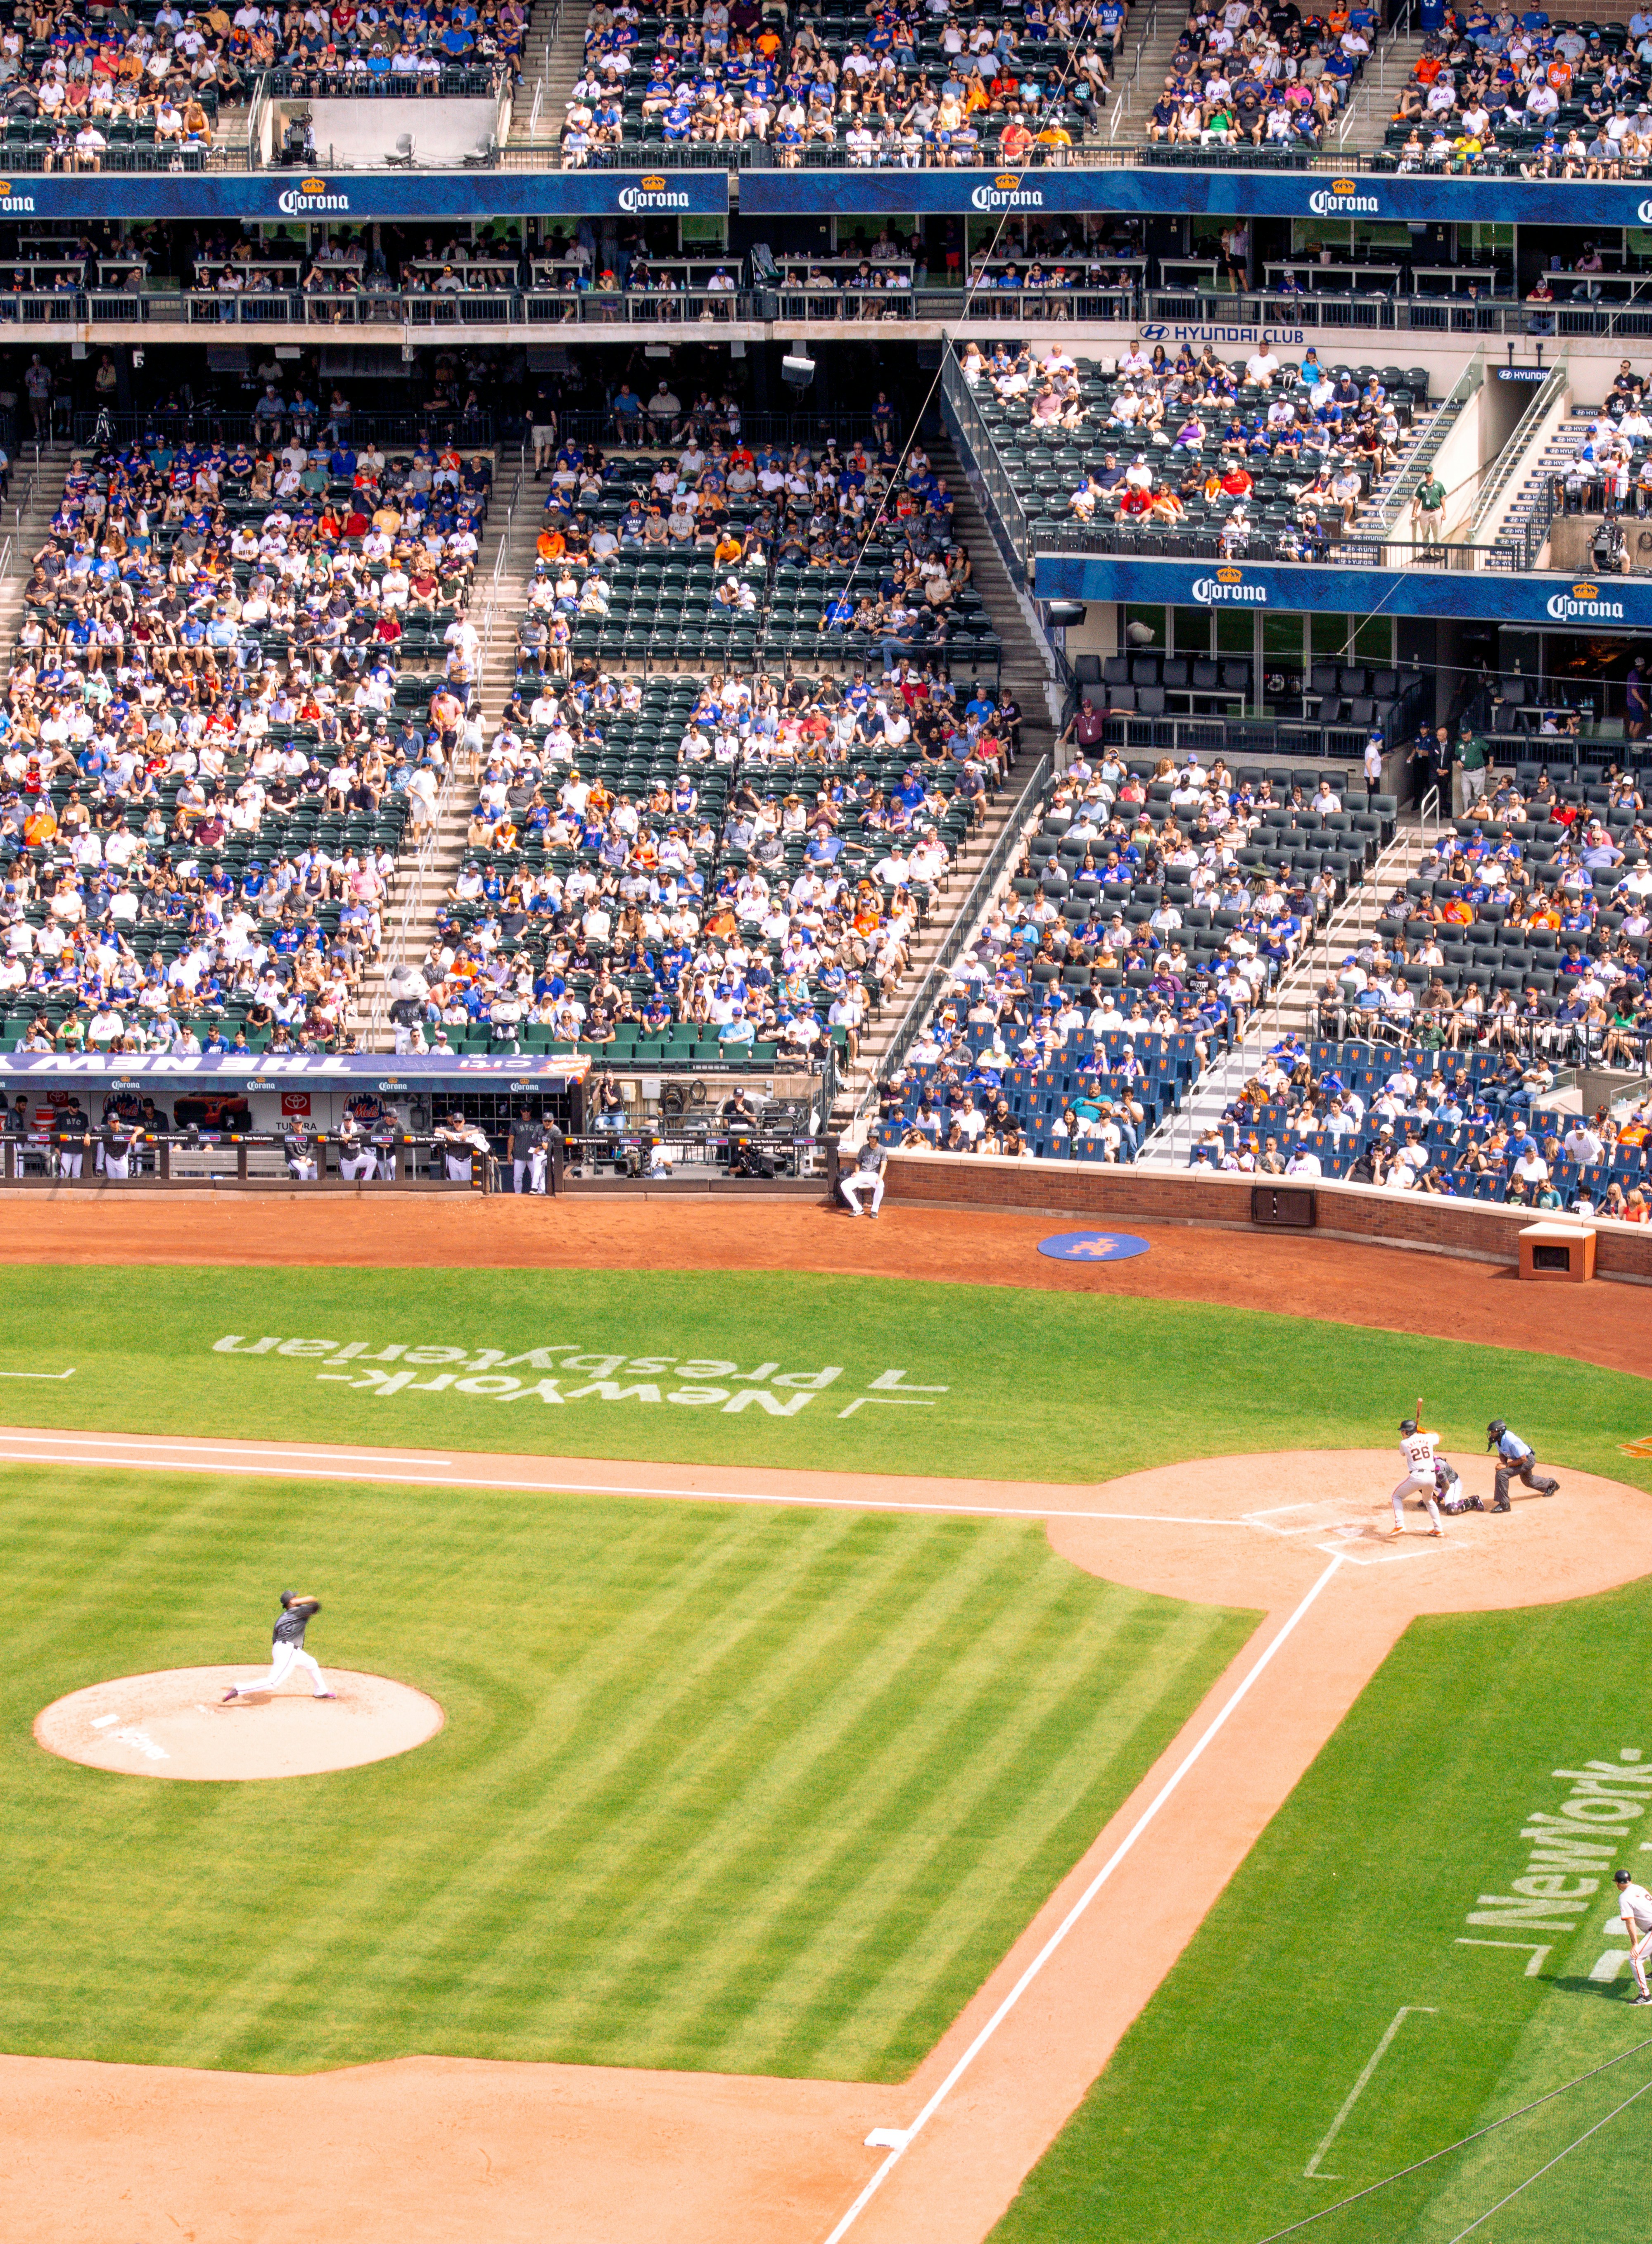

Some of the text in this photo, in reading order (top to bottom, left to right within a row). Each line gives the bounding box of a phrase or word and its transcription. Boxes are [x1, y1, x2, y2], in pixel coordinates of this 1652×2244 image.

[1533, 98, 1548, 107] Mets
[279, 190, 349, 215] Corona
[618, 187, 689, 213] Corona
[972, 186, 1042, 212] Corona
[1310, 190, 1378, 216] Corona
[1175, 326, 1303, 343] HYUNDAI CLUB
[1126, 357, 1142, 367] Mets
[1192, 578, 1266, 605] Corona
[1547, 594, 1623, 621] Corona
[1580, 991, 1597, 999] Mets
[29, 1056, 351, 1071] THE NEW
[112, 1081, 140, 1090] Corona
[247, 1081, 275, 1091] Corona
[379, 1082, 407, 1091] Corona
[510, 1083, 539, 1092] Corona
[354, 1103, 379, 1117] Mets
[211, 1335, 843, 1392] Presbyterian
[1410, 1446, 1430, 1462] 26
